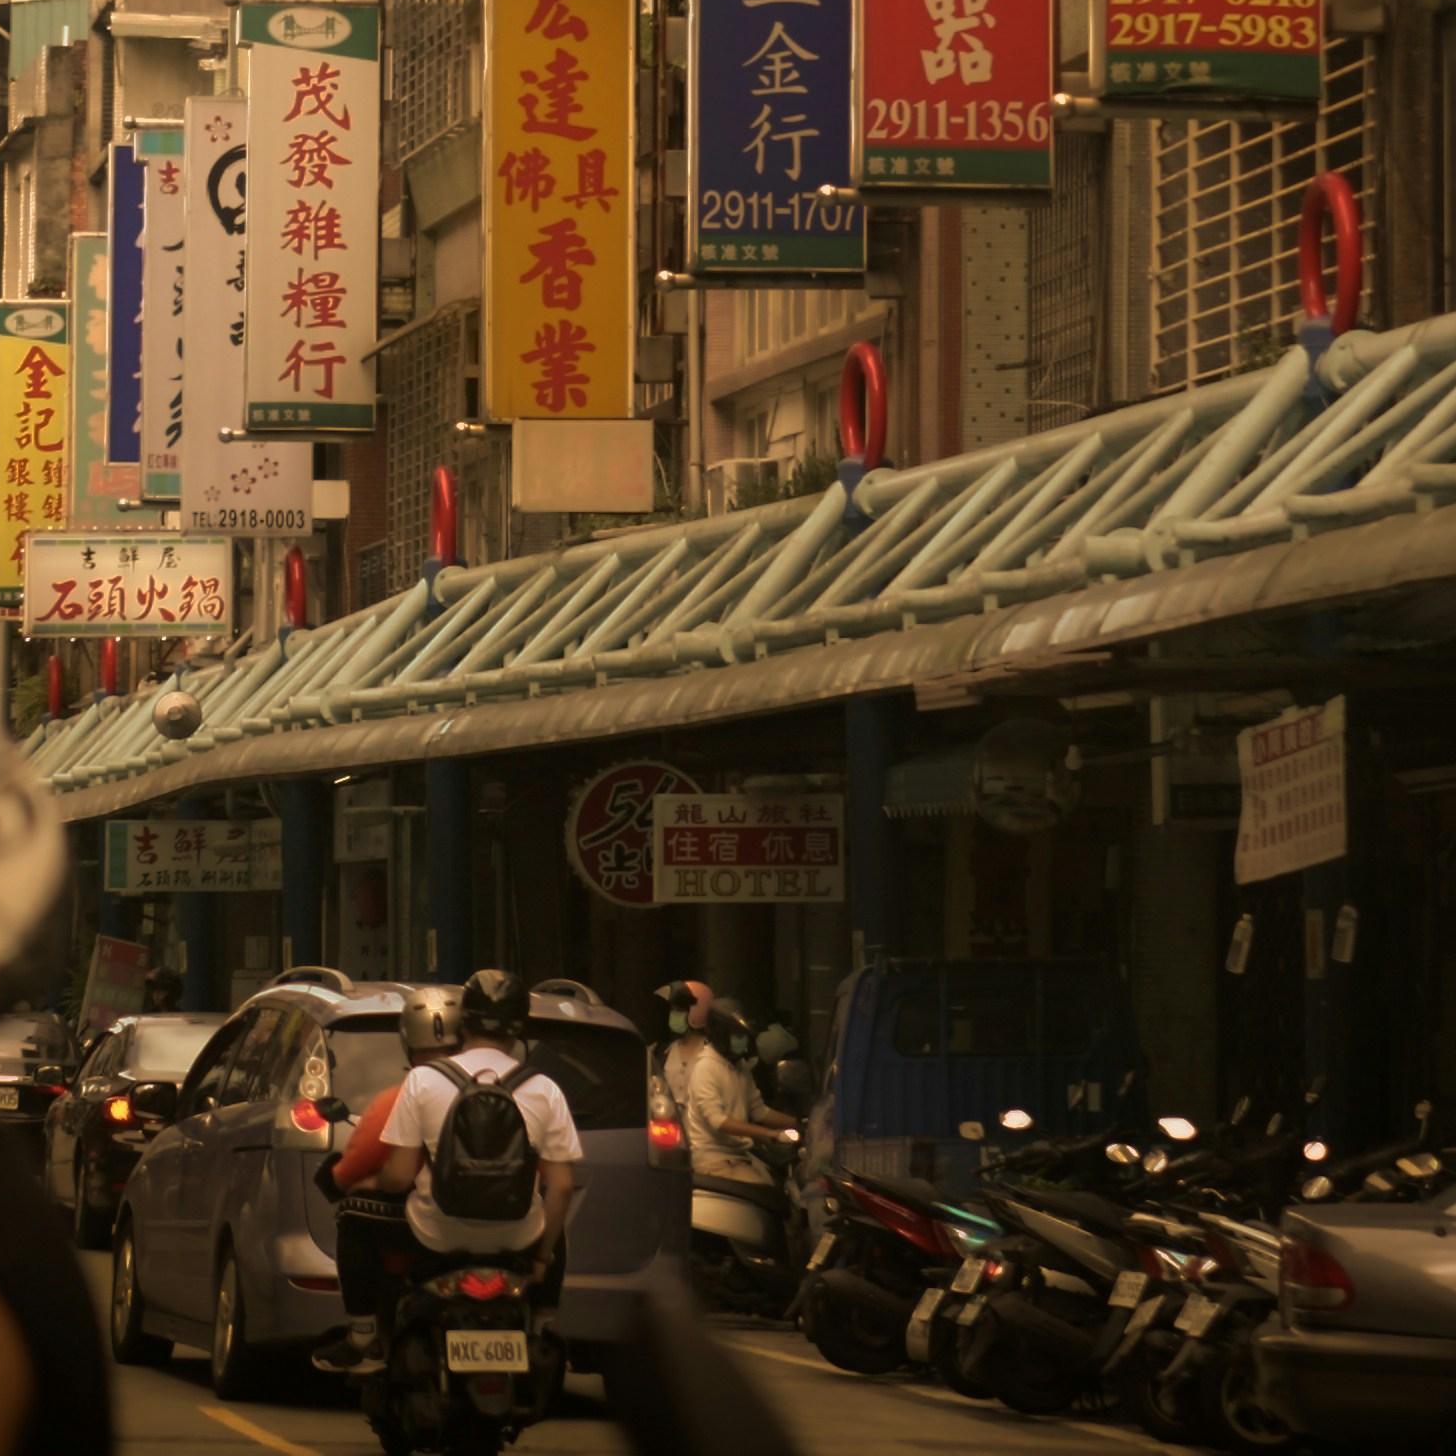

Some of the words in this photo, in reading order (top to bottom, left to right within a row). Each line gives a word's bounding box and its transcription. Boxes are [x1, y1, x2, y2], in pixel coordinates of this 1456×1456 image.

[1109, 12, 1318, 49] 2917-5983
[866, 98, 1050, 142] 2911-1356
[277, 61, 353, 400] 茂發雜糧行
[15, 345, 66, 453] 金記
[35, 575, 225, 623] 石頭火鍋
[675, 804, 832, 824] 龍山旅社
[667, 831, 741, 863] 住宿
[762, 831, 835, 864] 休息
[675, 869, 832, 897] HOTEL
